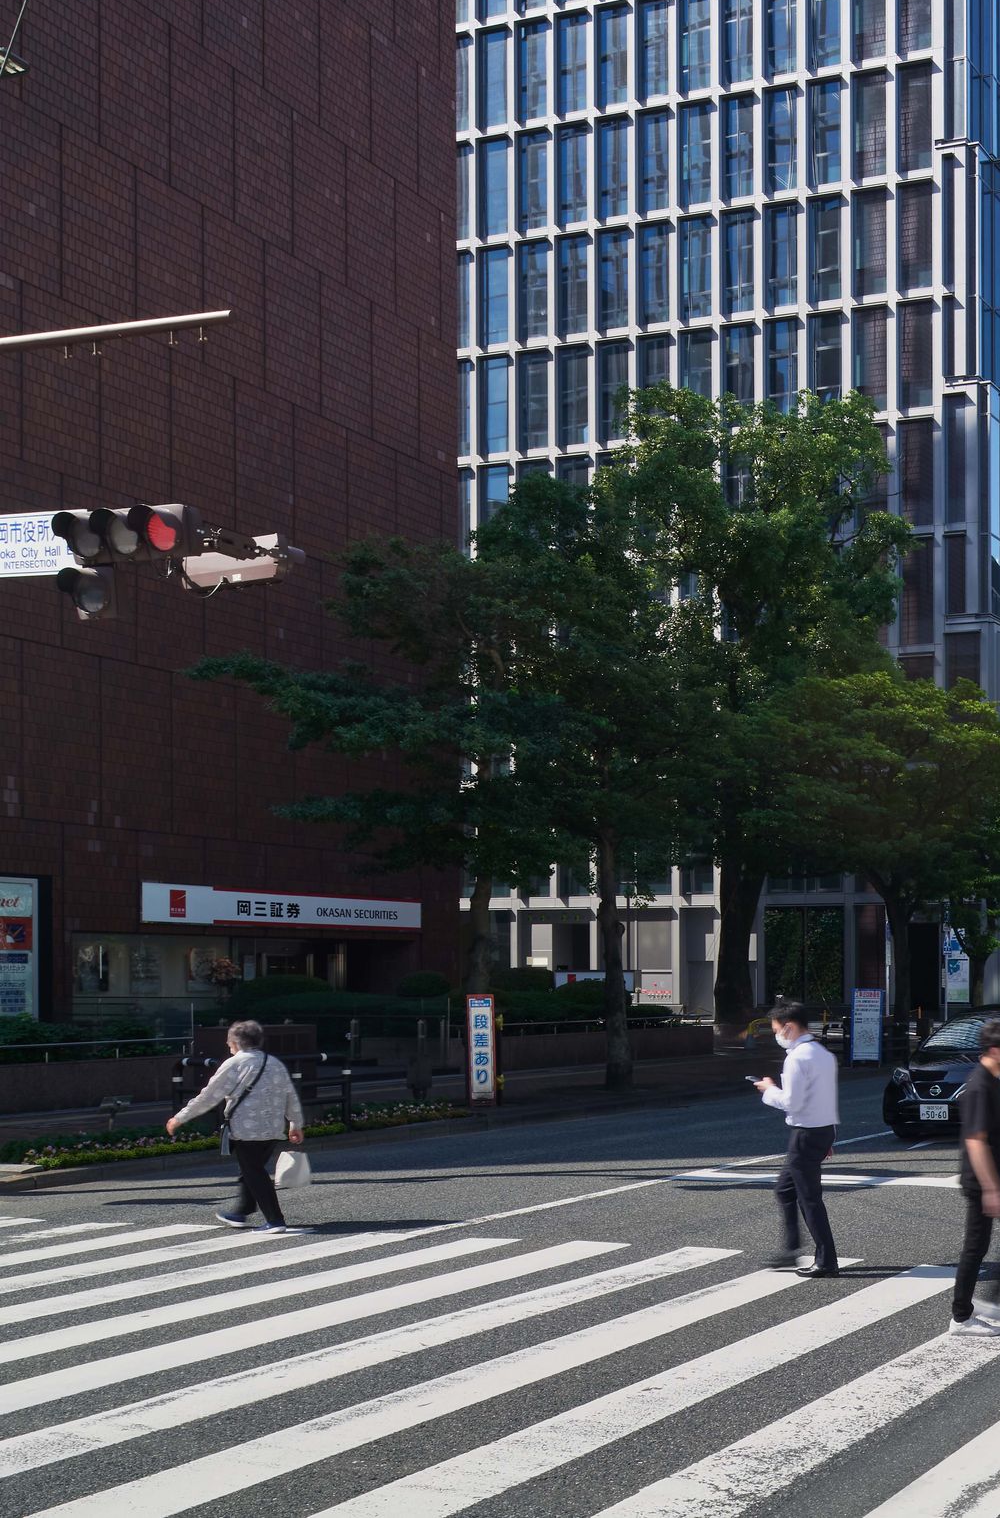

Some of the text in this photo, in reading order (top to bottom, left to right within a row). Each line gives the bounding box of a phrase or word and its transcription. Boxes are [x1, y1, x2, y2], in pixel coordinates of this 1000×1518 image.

[0, 520, 55, 543] 岡市役所
[21, 547, 38, 559] City
[44, 545, 61, 557] Hall
[4, 559, 57, 569] INTERSECTION
[236, 900, 301, 918] 岡三証券
[316, 907, 398, 920] OKASAN SECURITIES
[474, 1014, 489, 1084] 段差あり
